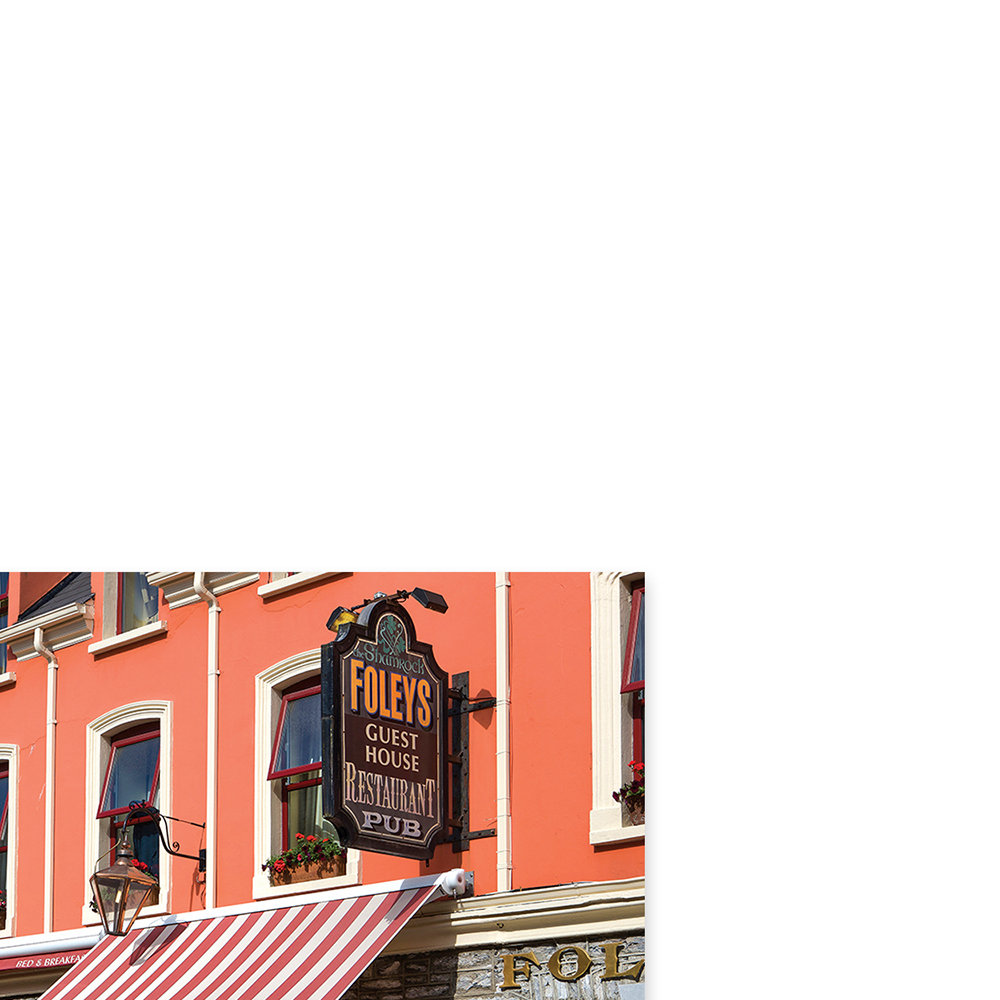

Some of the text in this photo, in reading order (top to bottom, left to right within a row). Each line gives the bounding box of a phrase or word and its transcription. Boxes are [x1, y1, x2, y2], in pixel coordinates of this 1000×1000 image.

[363, 643, 425, 675] Shamrock
[350, 657, 432, 729] FOLEYS
[365, 723, 419, 750] GUEST
[365, 745, 419, 772] HOUSE
[345, 761, 436, 818] RESTAURANT
[361, 810, 421, 837] PUB
[15, 959, 34, 968] BED
[36, 958, 42, 967] &
[499, 942, 645, 989] FOL
